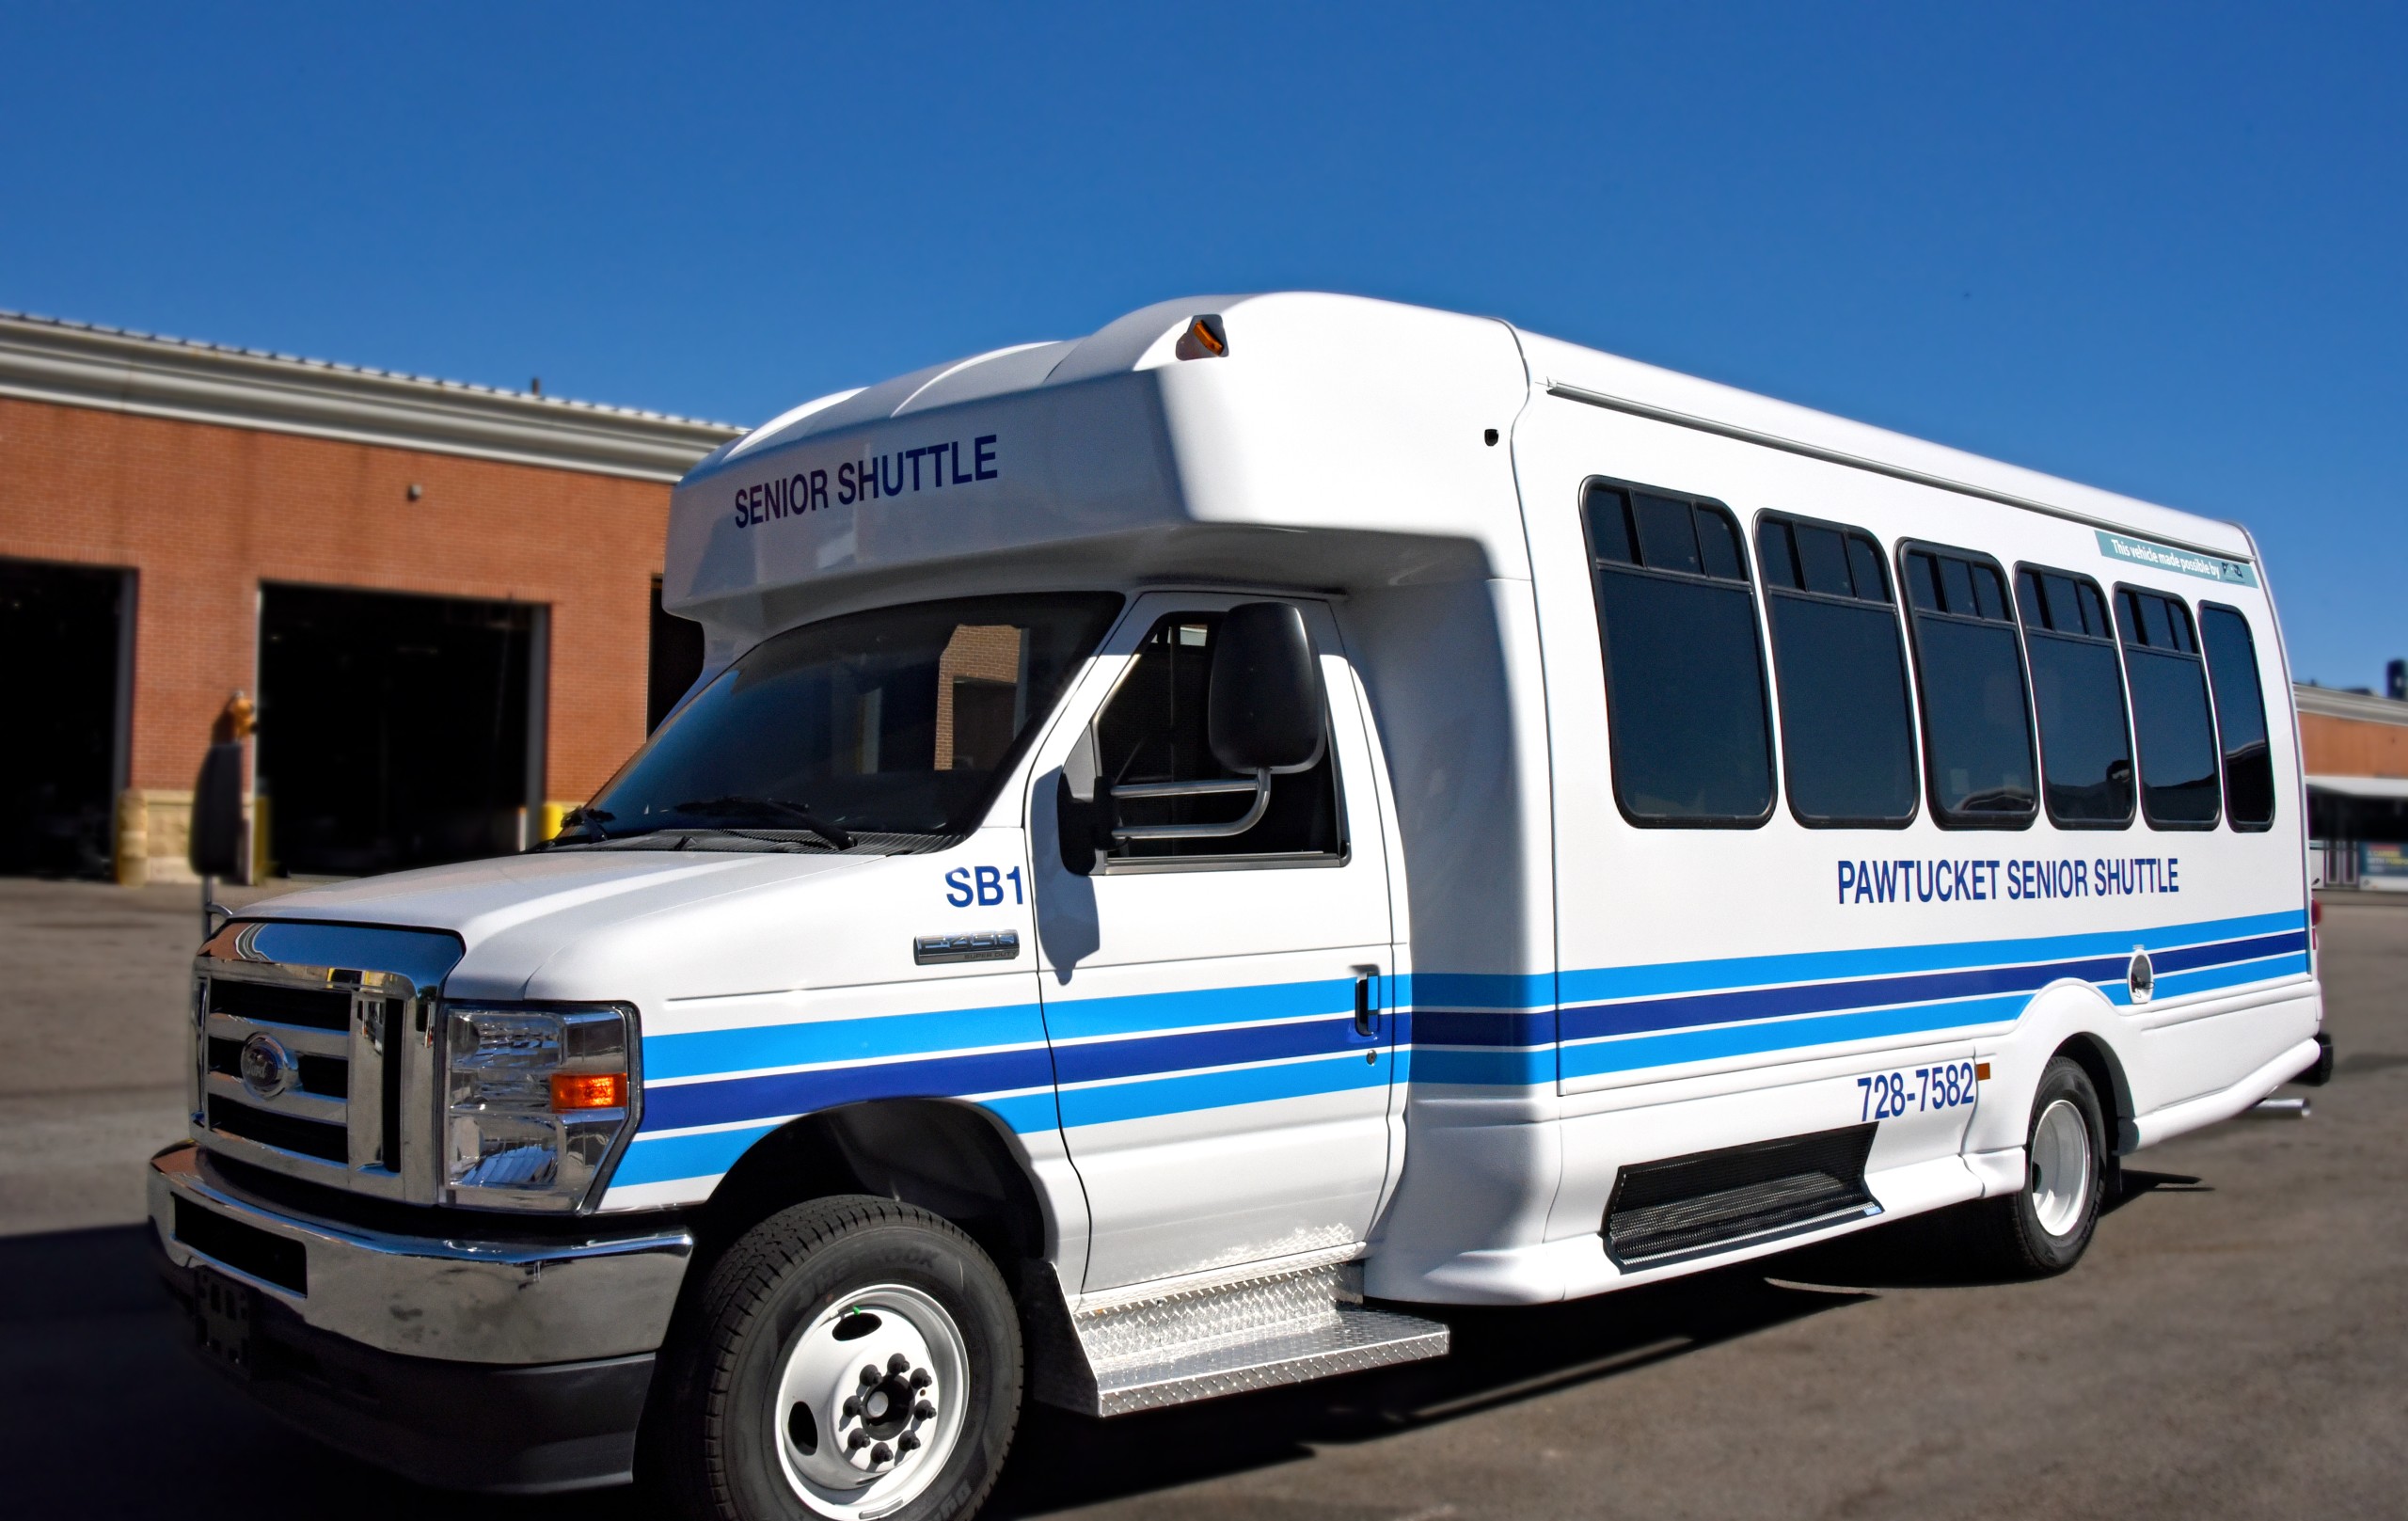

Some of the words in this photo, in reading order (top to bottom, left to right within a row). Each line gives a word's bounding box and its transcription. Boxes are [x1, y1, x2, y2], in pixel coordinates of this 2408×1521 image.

[735, 469, 830, 529] SENIOR
[837, 434, 998, 505] SHUTTLE
[2111, 538, 2131, 557] This
[2131, 545, 2158, 562] vehicle
[2158, 551, 2180, 567] made
[2180, 557, 2210, 574] possible
[2210, 562, 2221, 579] by
[944, 865, 1023, 908] SB1
[1837, 859, 2000, 904] PAWTUCKET
[2007, 859, 2088, 899] SENIOR
[2094, 857, 2179, 896] SHUTTLE
[1857, 1062, 1974, 1122] 728-7582
